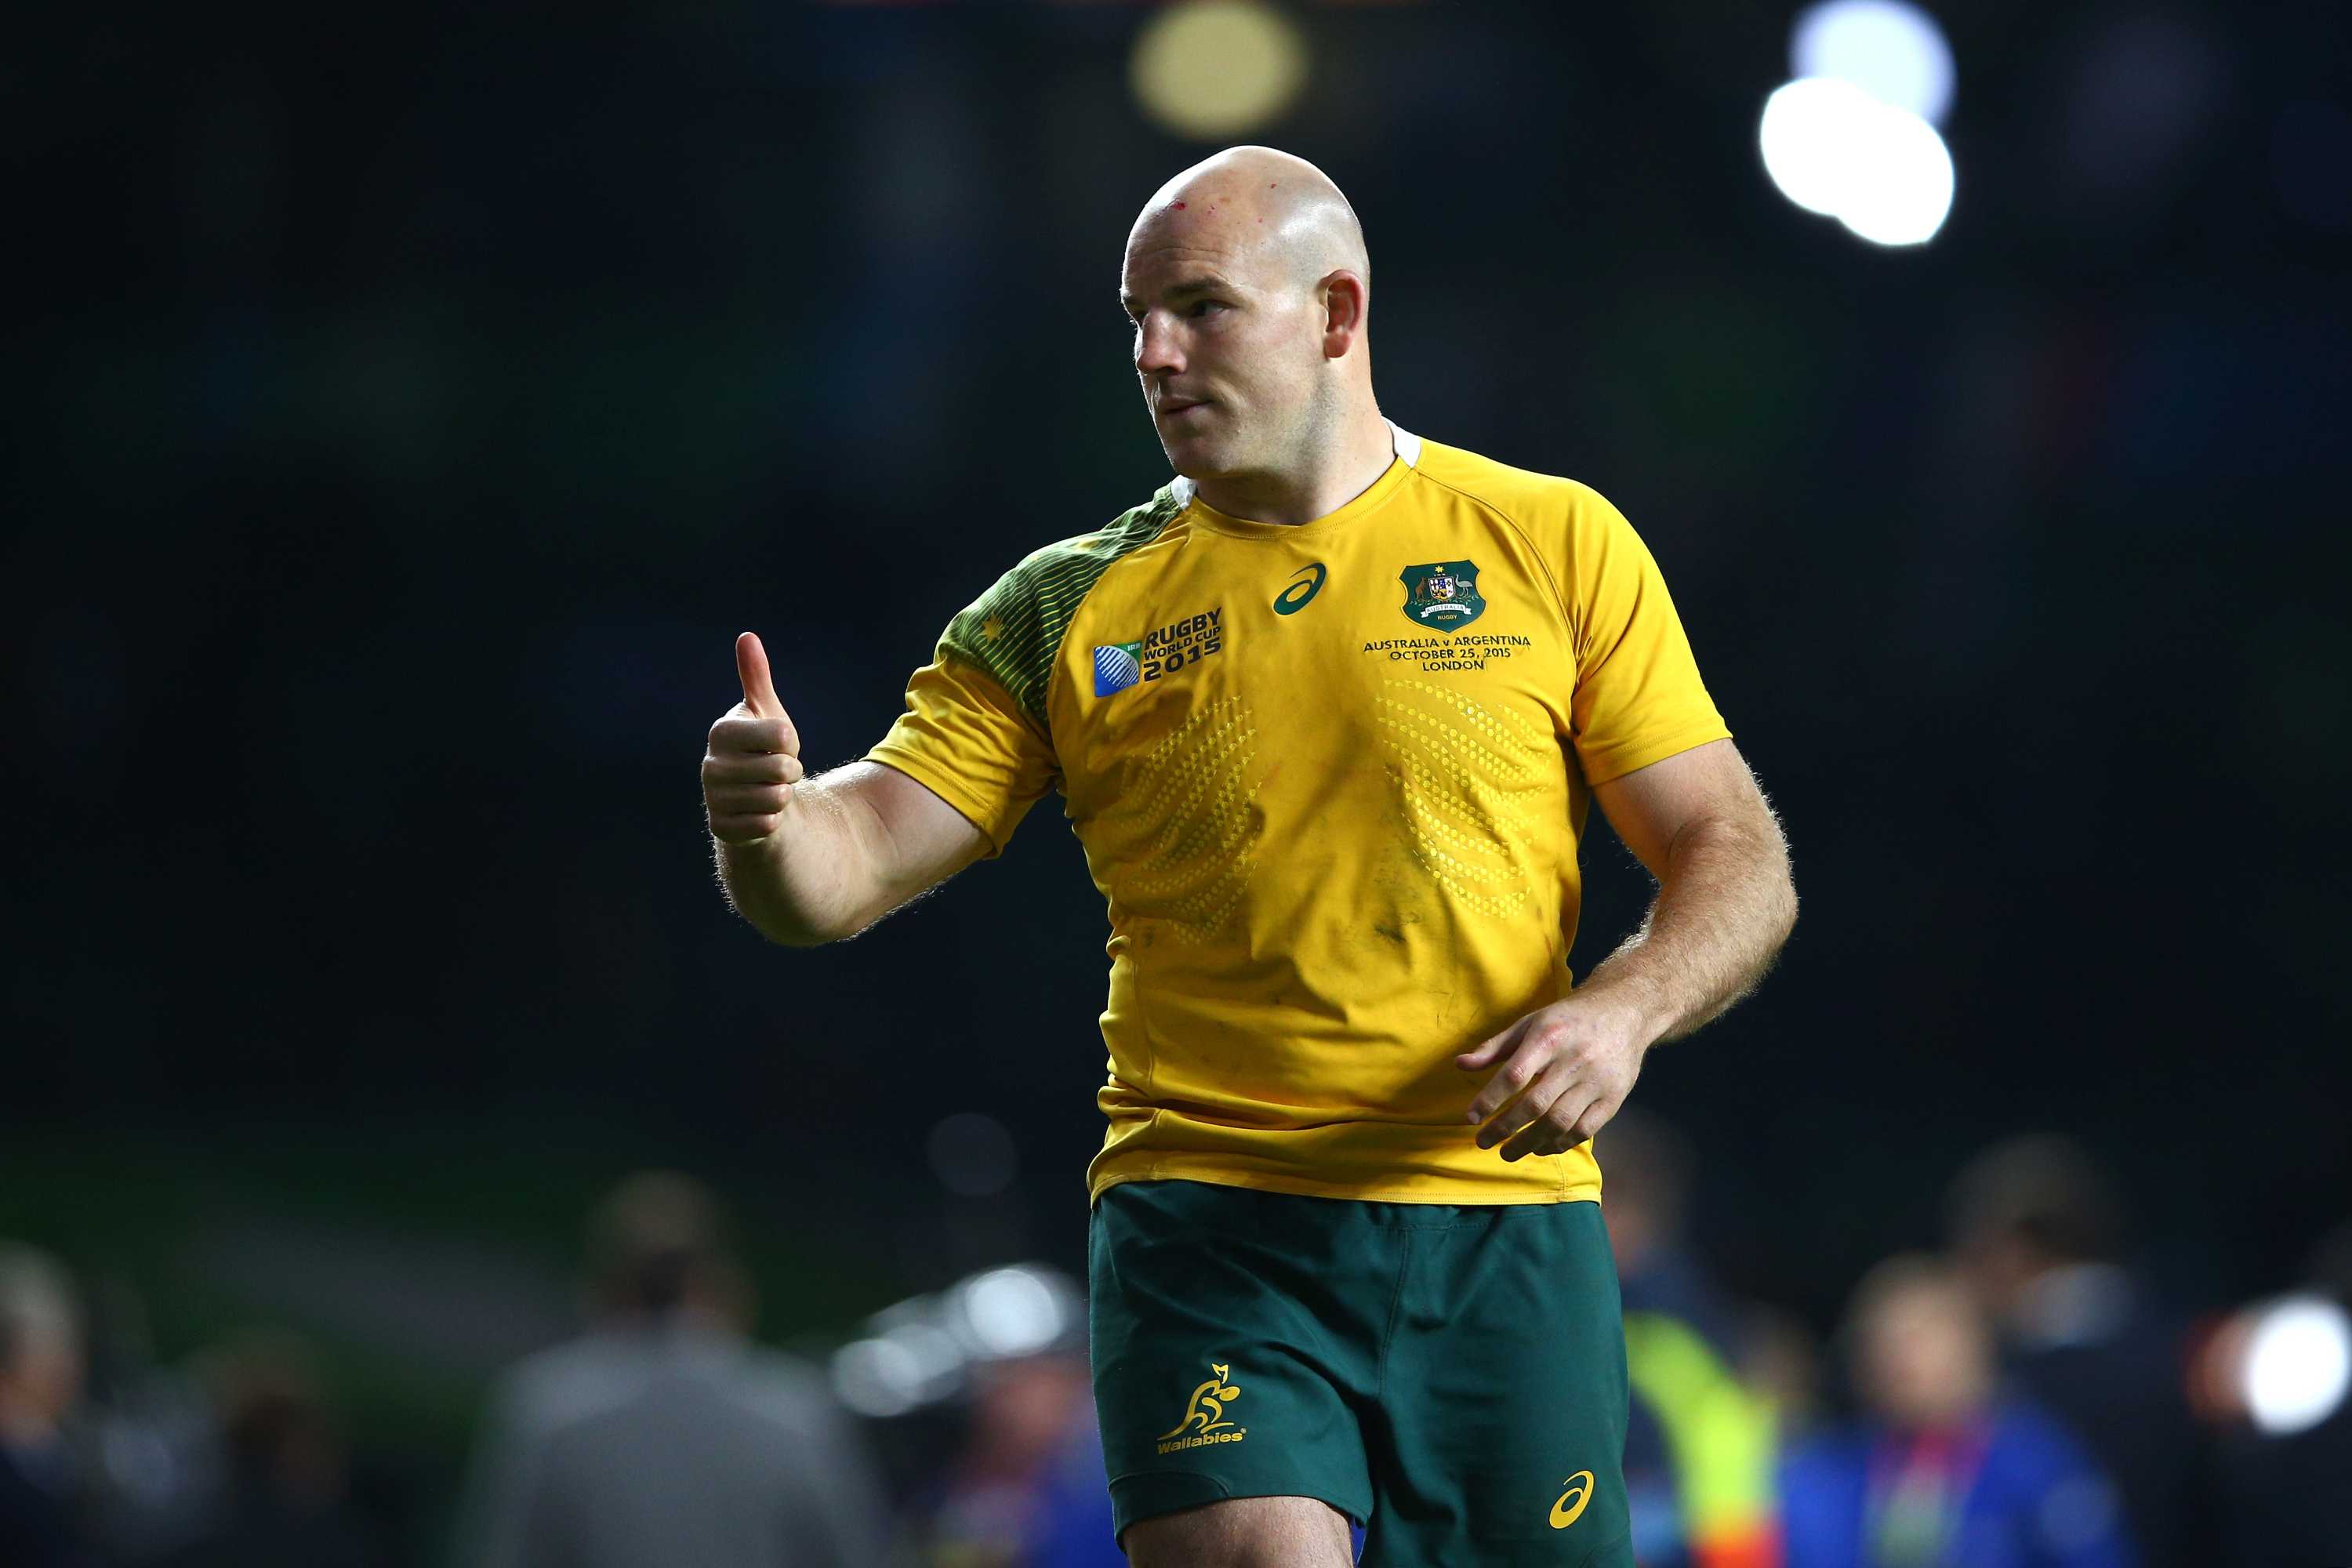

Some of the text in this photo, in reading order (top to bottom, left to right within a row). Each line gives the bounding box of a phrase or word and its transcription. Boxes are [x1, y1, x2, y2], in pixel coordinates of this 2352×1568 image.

[1145, 607, 1221, 650] RUGBY
[1144, 626, 1221, 661] WORLD CUP
[1363, 637, 1439, 652] AUSTRALIA
[1454, 635, 1531, 648] ARGENTINA
[1390, 648, 1511, 660] OCTOBER 25, 2015
[1143, 637, 1221, 682] 2015
[1422, 660, 1484, 672] LONDON
